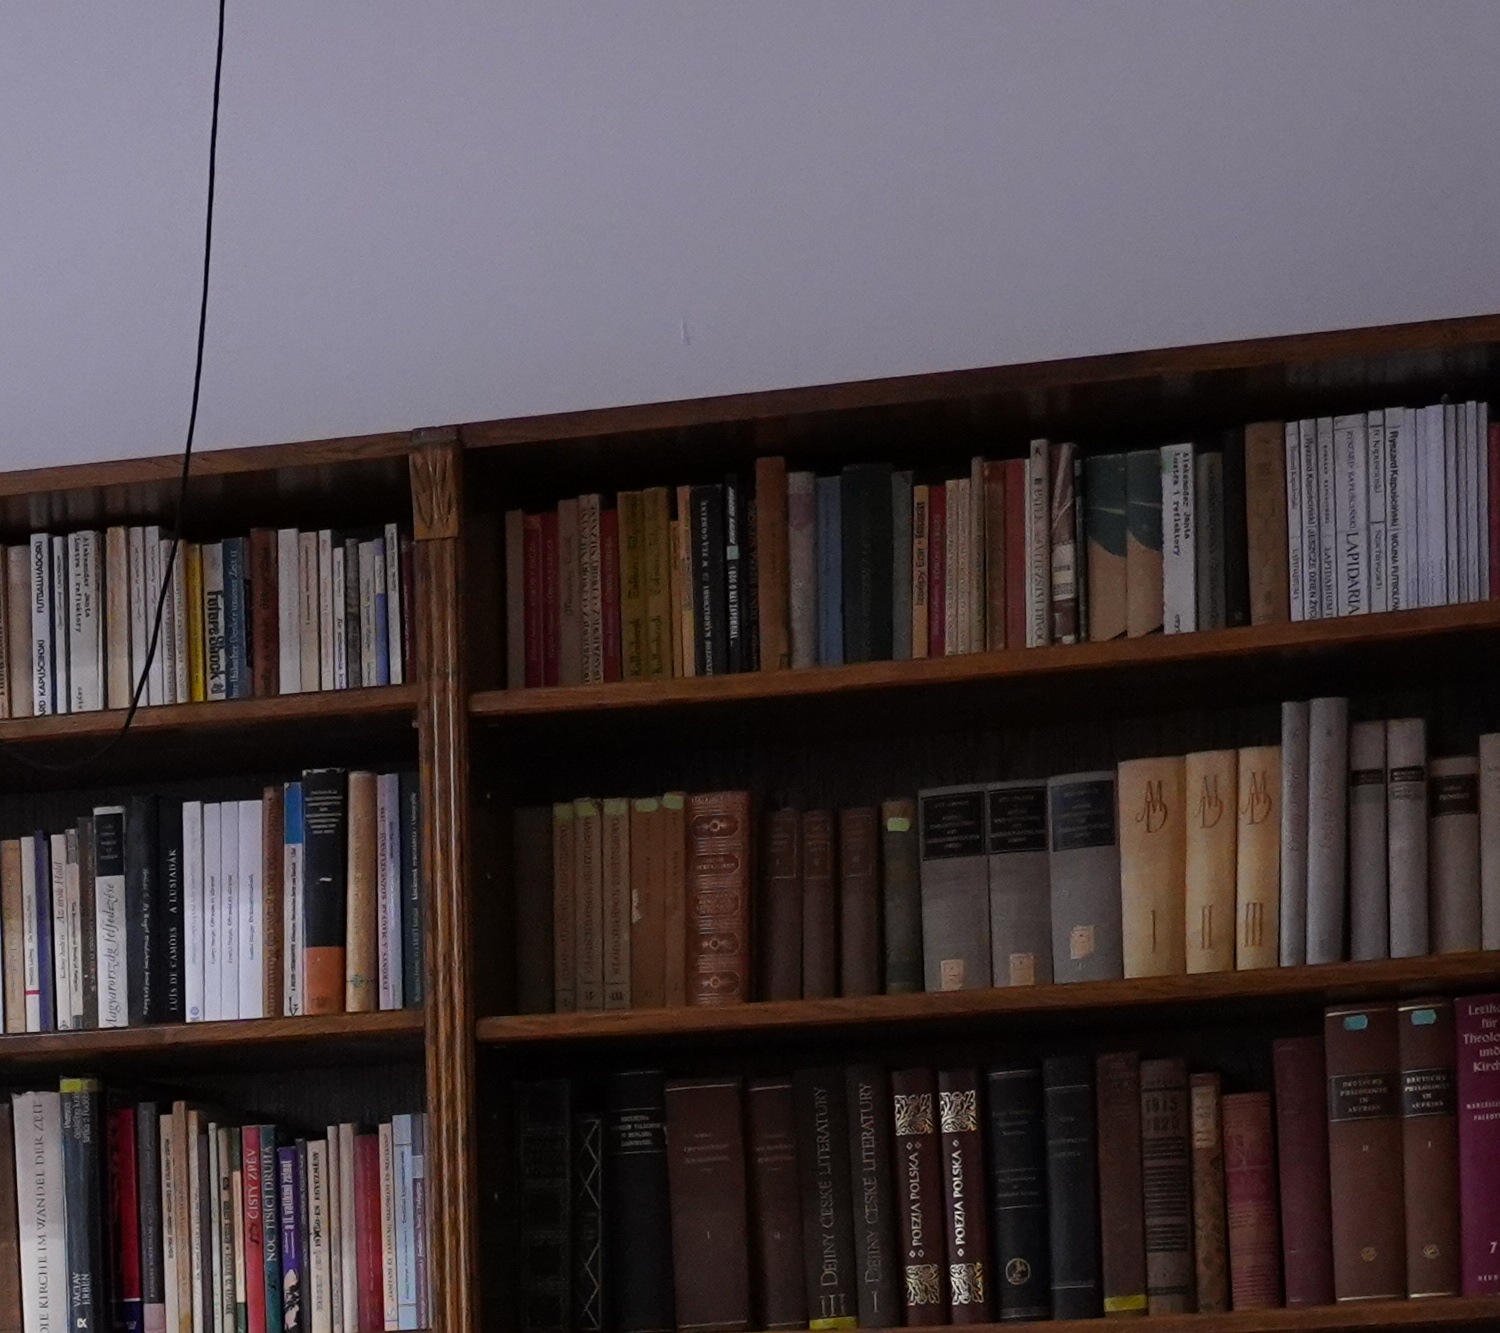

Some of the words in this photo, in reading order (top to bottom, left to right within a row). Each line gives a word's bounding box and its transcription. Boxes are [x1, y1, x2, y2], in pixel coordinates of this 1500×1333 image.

[1388, 430, 1400, 467] Ryszard
[1388, 469, 1400, 528] Kapuściński
[1345, 533, 1360, 611] LAPIDARIA
[167, 848, 178, 903] LUSIADÁK
[167, 926, 178, 968] CAMÕES
[168, 971, 178, 984] DE
[168, 987, 178, 1011] LUÍS
[1481, 1017, 1498, 1028] für
[1479, 1046, 1500, 1058] und
[33, 1102, 43, 1131] ZEIT
[813, 1087, 831, 1176] LITERATURY
[858, 1083, 876, 1172] LITERATURY
[35, 1138, 45, 1165] DER
[245, 1148, 257, 1181] ZPĚV
[908, 1152, 921, 1200] POLSKA
[951, 1150, 964, 1198] POLSKA
[36, 1172, 47, 1228] WANDEL
[246, 1184, 259, 1219] ČISTÝ
[37, 1232, 47, 1252] IM
[910, 1202, 923, 1247] POEZJA
[953, 1201, 966, 1245] POEZJA
[1490, 1241, 1498, 1254] 7
[38, 1257, 49, 1309] KIRCHE
[81, 1272, 91, 1306] ERBEN
